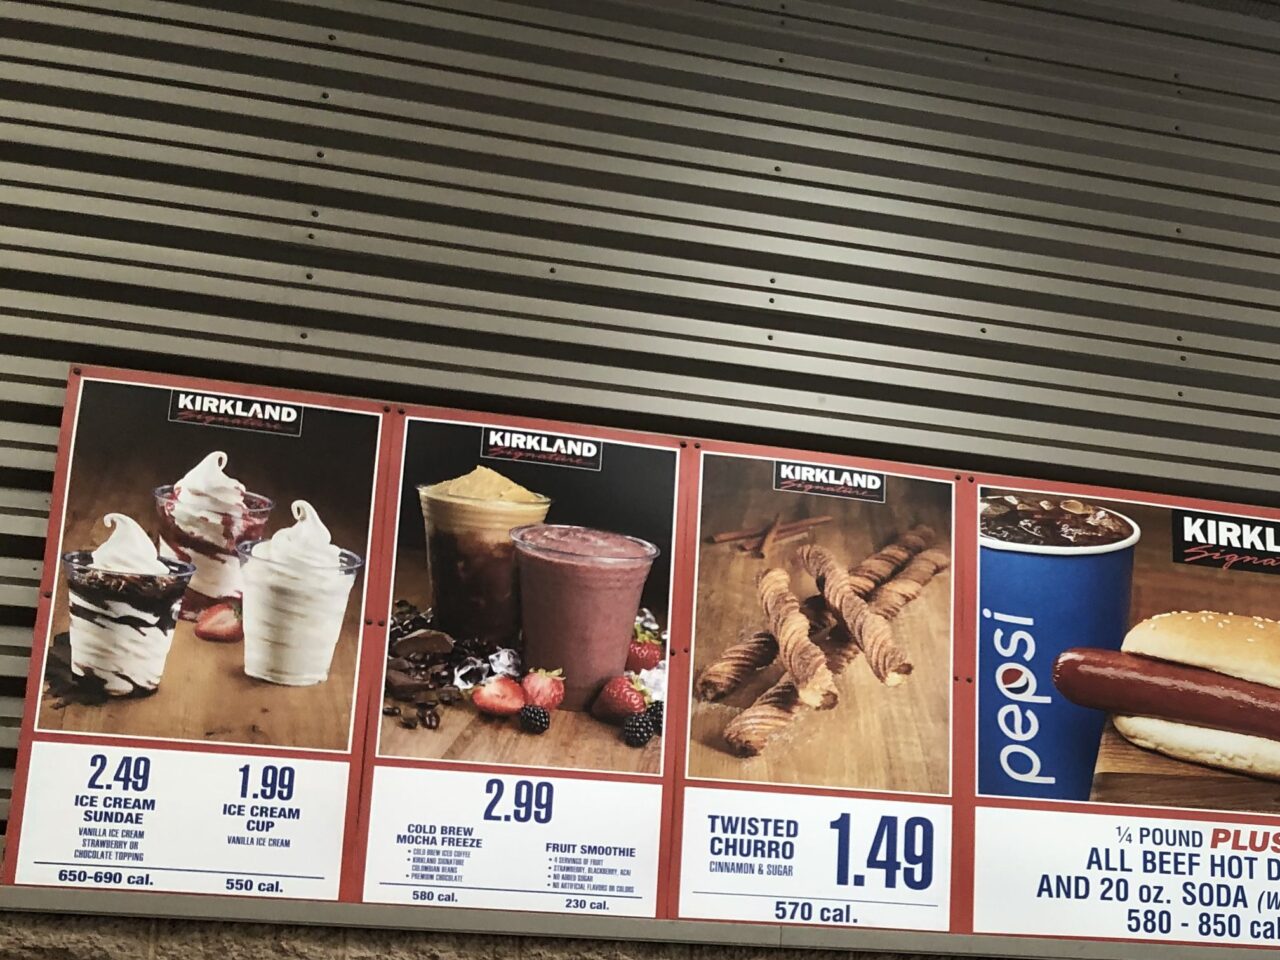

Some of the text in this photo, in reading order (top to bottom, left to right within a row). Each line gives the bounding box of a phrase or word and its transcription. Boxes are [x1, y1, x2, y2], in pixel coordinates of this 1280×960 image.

[178, 393, 297, 422] KIRKLAND
[489, 430, 597, 457] KIRKLAND
[780, 464, 881, 489] KIRKLAND
[982, 608, 1056, 784] pepsi
[88, 754, 151, 792] 2.49
[239, 764, 295, 801] 1.99
[74, 795, 156, 810] ICE CREAM
[483, 778, 554, 824] 2.99
[83, 810, 144, 824] SUNDAE
[222, 803, 301, 820] ICE CREAM
[78, 827, 144, 839] VANILLA ICE CREAM
[246, 820, 275, 832] CUP
[407, 824, 474, 836] COLD BREW
[708, 814, 799, 838] TWISTED
[82, 838, 139, 850] STRAWBERRY OR
[227, 835, 290, 848] VANILLA ICE CREAM
[396, 834, 483, 848] MOCHA FREEZE
[1139, 828, 1203, 848] POUND
[74, 849, 144, 861] CHOCOLATE TOPPING
[546, 842, 636, 857] FRUIT SMOOTHIE
[709, 836, 795, 860] CHURRO
[830, 812, 934, 891] 1.49
[709, 861, 793, 877] CINNAMON & SUGAR
[1086, 847, 1133, 872] ALL
[1142, 850, 1201, 876] BEEF
[1210, 854, 1258, 880] HOT
[58, 869, 153, 886] 650-690 cal.
[225, 878, 283, 893] 550 cal.
[412, 890, 458, 903] 580 cal.
[1037, 874, 1090, 900] AND
[1100, 877, 1129, 902] 20
[1139, 885, 1171, 904] oz.
[1182, 881, 1249, 909] SODA
[565, 899, 610, 910] 230 cal.
[775, 901, 858, 923] 570 cal.
[1127, 909, 1172, 934] 580
[1198, 912, 1241, 938] 850
